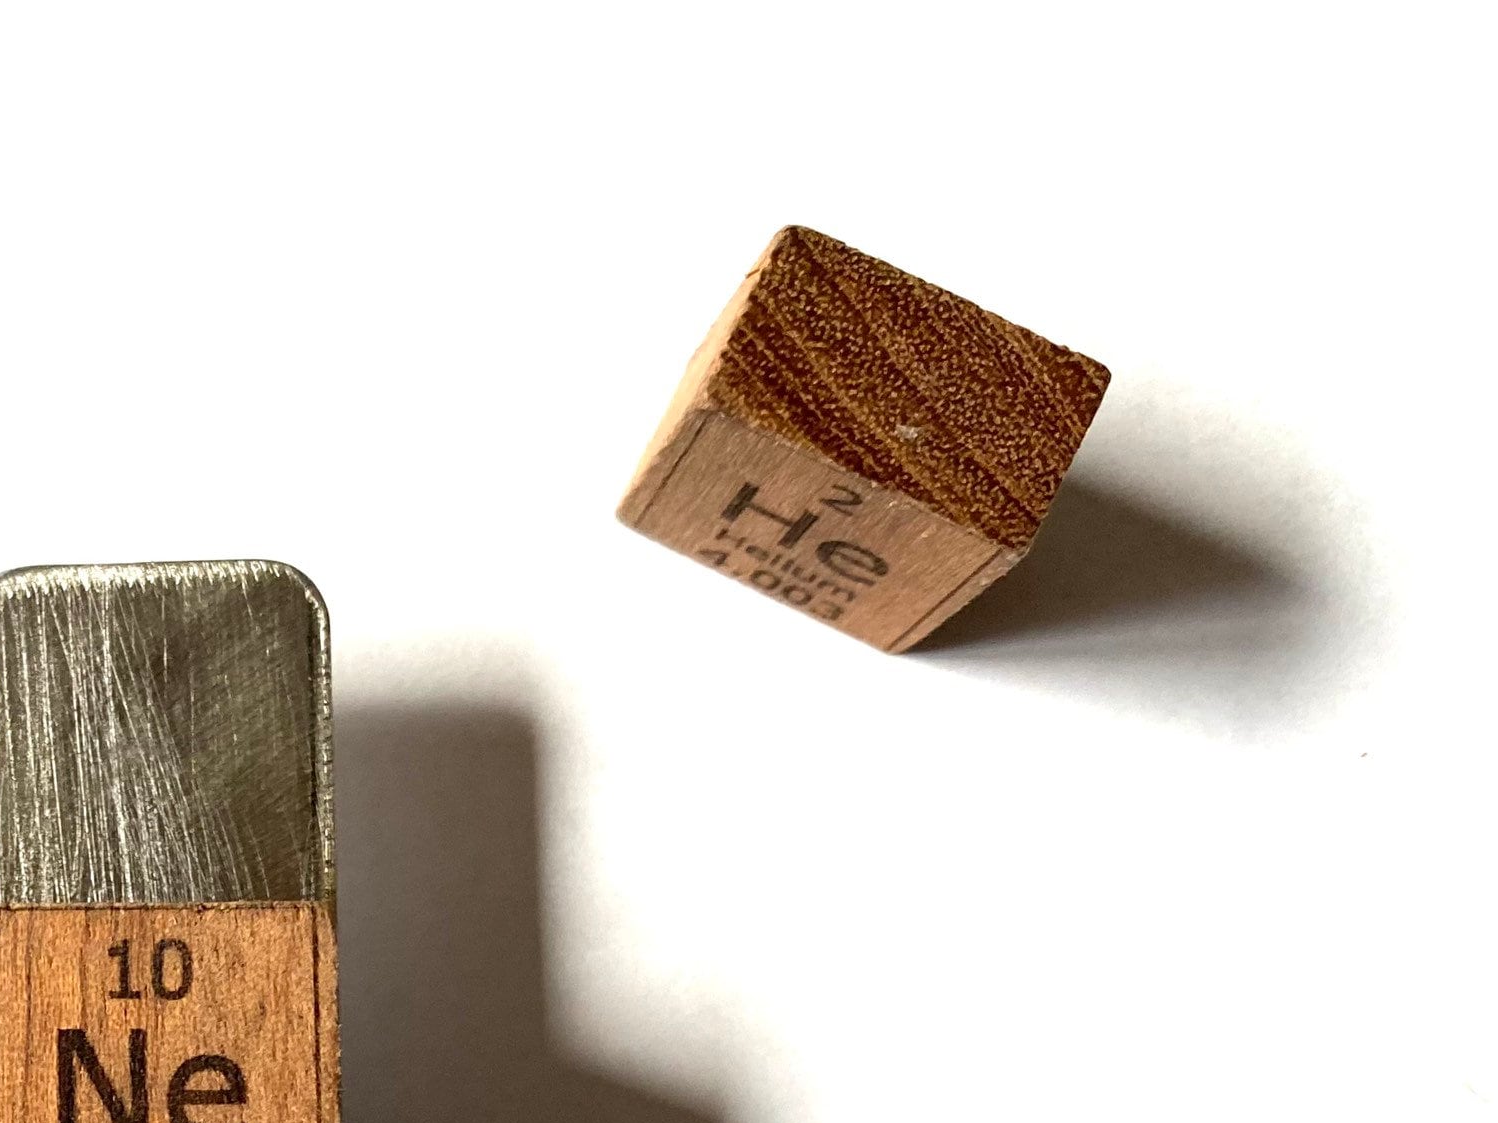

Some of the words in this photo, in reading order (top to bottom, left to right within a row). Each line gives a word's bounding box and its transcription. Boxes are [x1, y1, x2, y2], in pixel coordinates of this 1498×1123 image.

[720, 480, 889, 587] He
[819, 484, 863, 514] 2
[697, 545, 844, 622] 4.003
[714, 527, 855, 603] Helium
[107, 938, 194, 1000] 10
